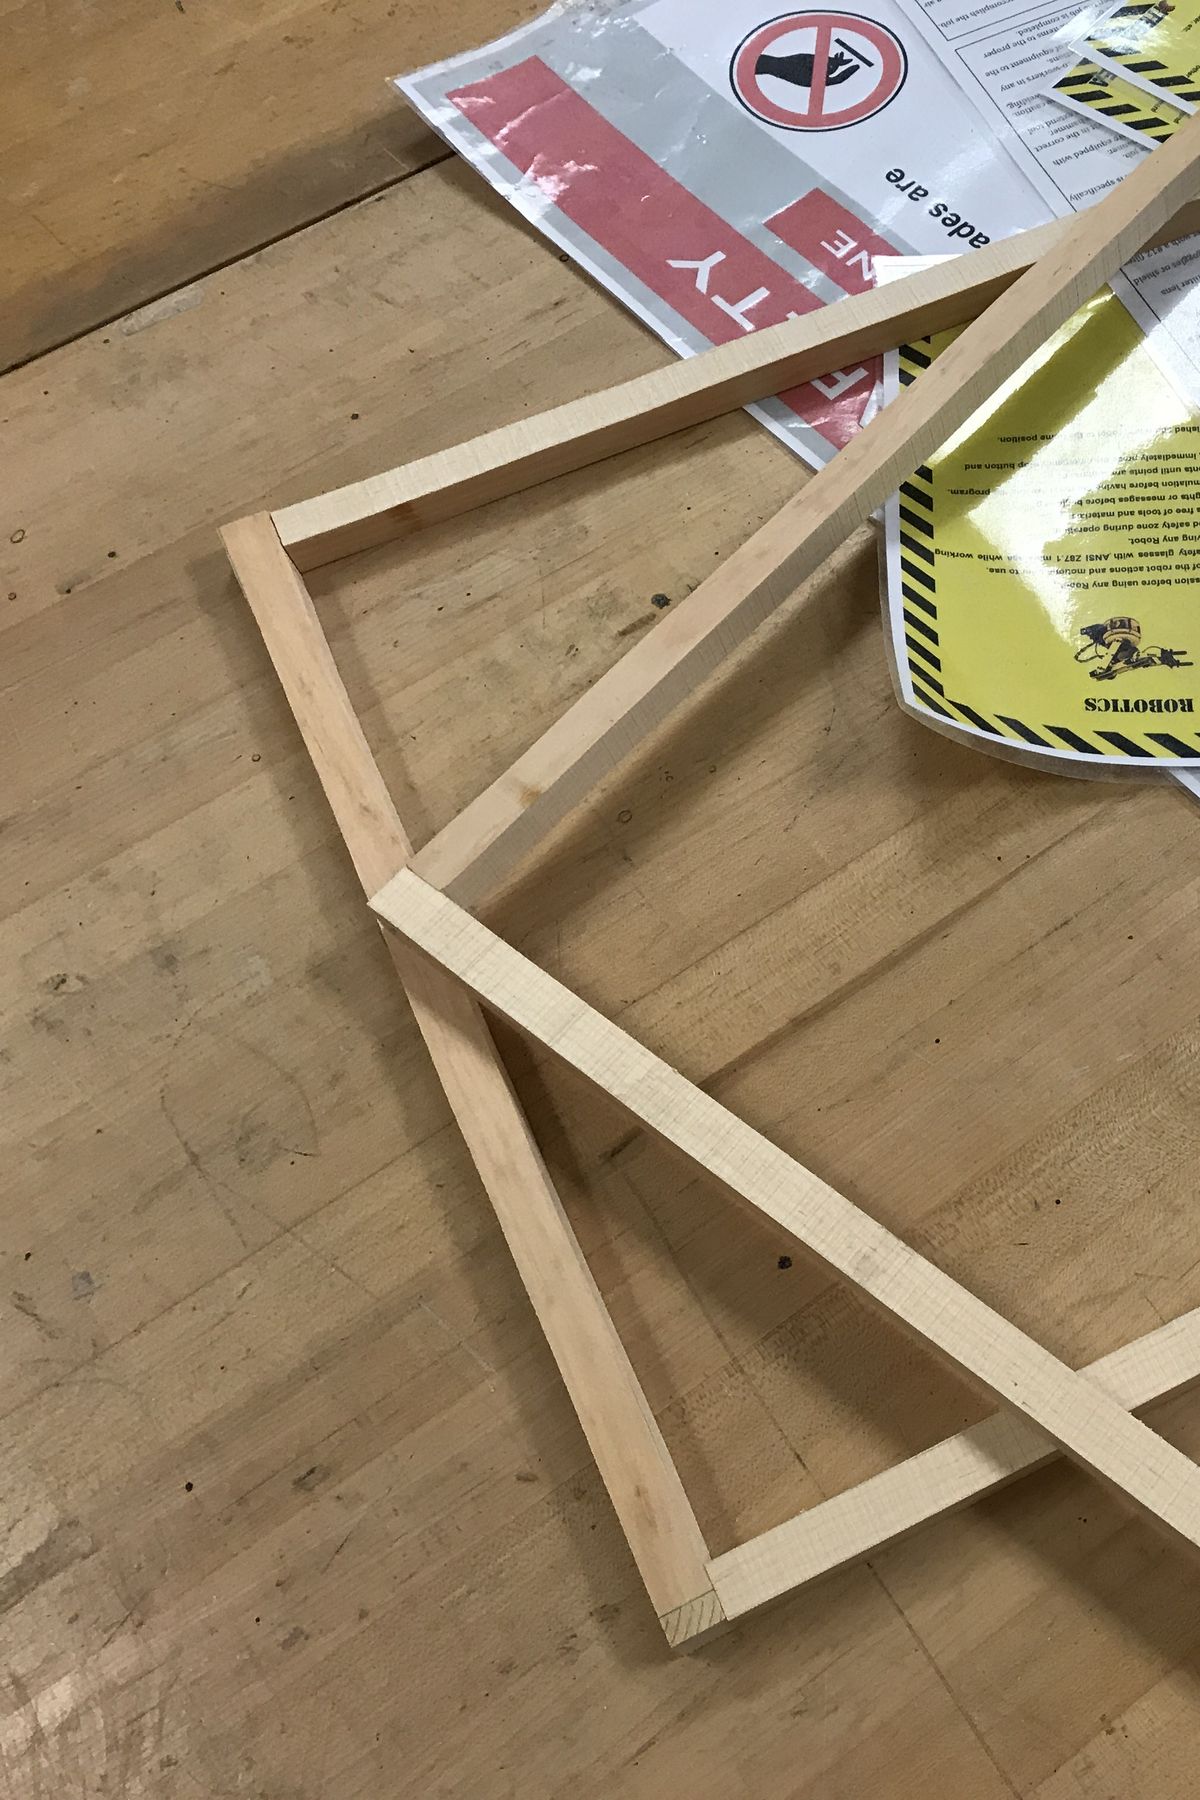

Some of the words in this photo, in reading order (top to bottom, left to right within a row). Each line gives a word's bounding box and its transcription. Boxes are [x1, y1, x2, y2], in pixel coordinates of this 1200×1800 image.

[881, 163, 929, 207] are
[923, 198, 991, 257] ades
[819, 228, 873, 286] NE
[996, 434, 1037, 443] position.
[947, 486, 990, 497] program.
[1118, 494, 1164, 503] messages
[1103, 523, 1133, 532] during
[1136, 522, 1159, 530] zone
[1162, 520, 1189, 529] safety
[1127, 535, 1159, 545] Robot.
[934, 548, 973, 559] working
[1113, 551, 1133, 560] with
[1137, 549, 1173, 558] glasses
[1146, 563, 1172, 572] robot
[1111, 578, 1138, 588] using
[1141, 577, 1171, 586] before
[1083, 697, 1193, 712] ROBOTICS
